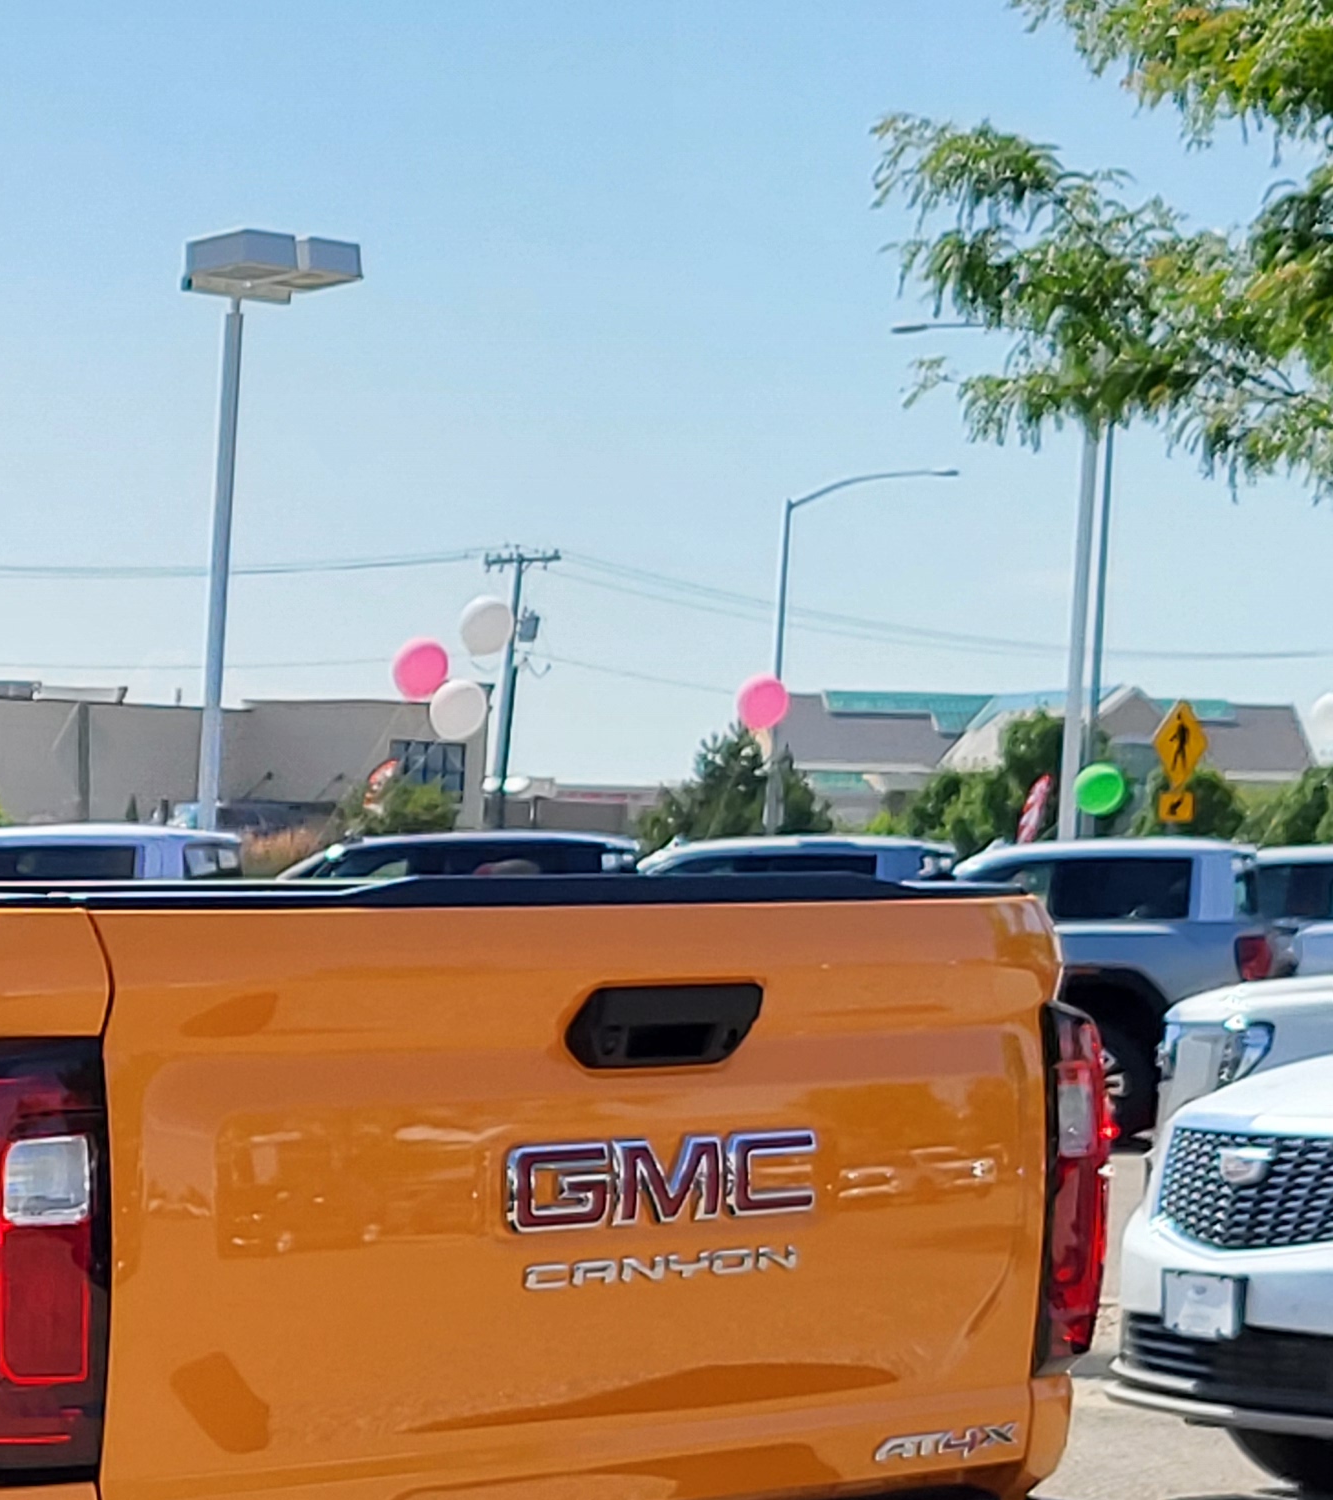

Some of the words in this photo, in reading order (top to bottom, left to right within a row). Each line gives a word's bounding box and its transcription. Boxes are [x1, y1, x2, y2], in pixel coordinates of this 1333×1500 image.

[506, 1128, 817, 1233] GMC
[523, 1244, 798, 1290] CANYON
[874, 1421, 1019, 1462] AT4X
